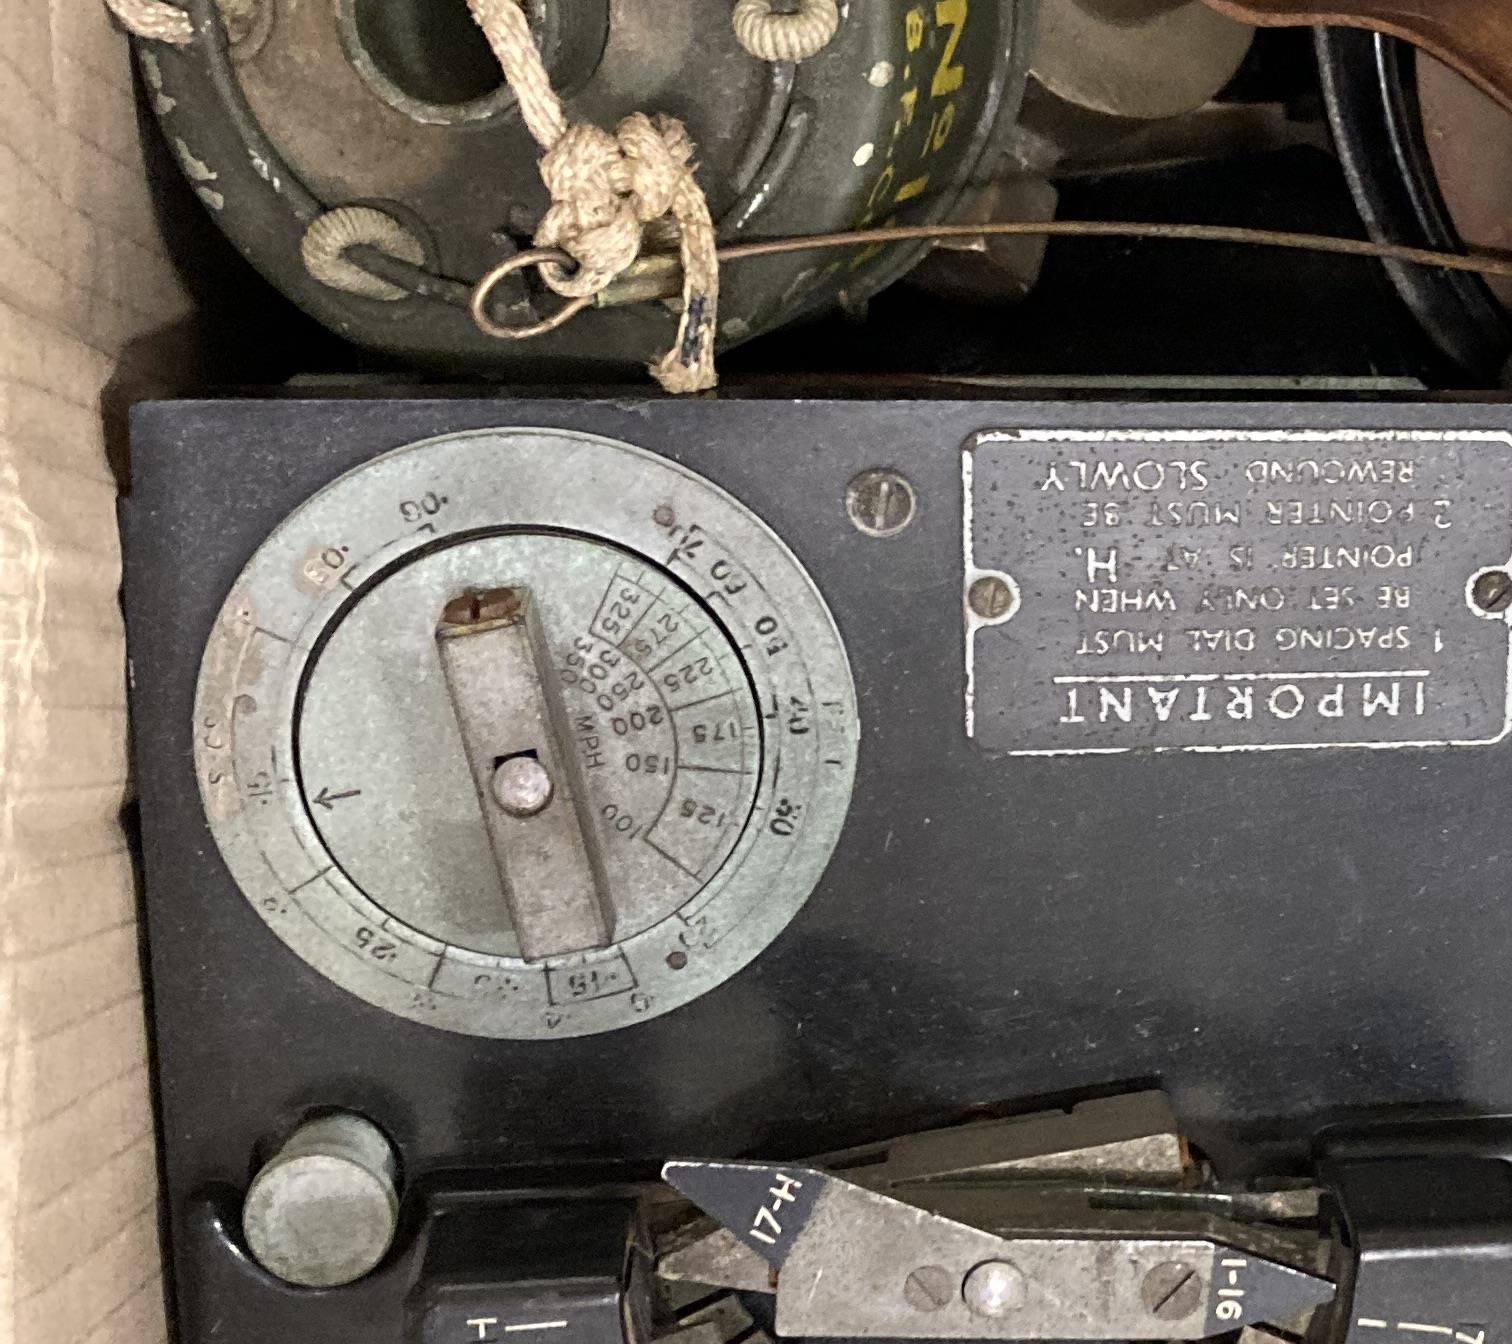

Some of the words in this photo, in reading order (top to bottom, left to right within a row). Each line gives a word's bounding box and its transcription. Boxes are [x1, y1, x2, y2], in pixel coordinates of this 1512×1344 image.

[1040, 459, 1209, 493] SLOWLY
[1245, 459, 1415, 485] REWOUND
[1081, 500, 1120, 528] BE
[1147, 500, 1242, 527] MUST
[1265, 500, 1415, 526] POINTER
[1166, 542, 1206, 573] AT
[1230, 543, 1254, 568] IS
[1281, 543, 1414, 570] POINTER
[1073, 587, 1178, 614] WHEN
[1197, 587, 1285, 613] ONLY
[1305, 585, 1356, 610] SET
[1377, 584, 1411, 609] BE
[602, 586, 641, 636] 325
[1075, 628, 1164, 655] MUST
[1184, 626, 1256, 654] DIAL
[1275, 623, 1411, 652] SPACING
[560, 636, 594, 685] 350
[664, 656, 714, 693] 225
[596, 670, 645, 712] 250
[1059, 681, 1426, 724] IMPORTANT
[611, 704, 665, 737] 200
[693, 721, 738, 743] 175
[575, 714, 606, 769] MPH
[625, 752, 671, 773] 150
[602, 803, 644, 840] 100
[680, 797, 726, 828] 125
[749, 1172, 804, 1246] 17-H
[1214, 1258, 1247, 1321] 1-16
